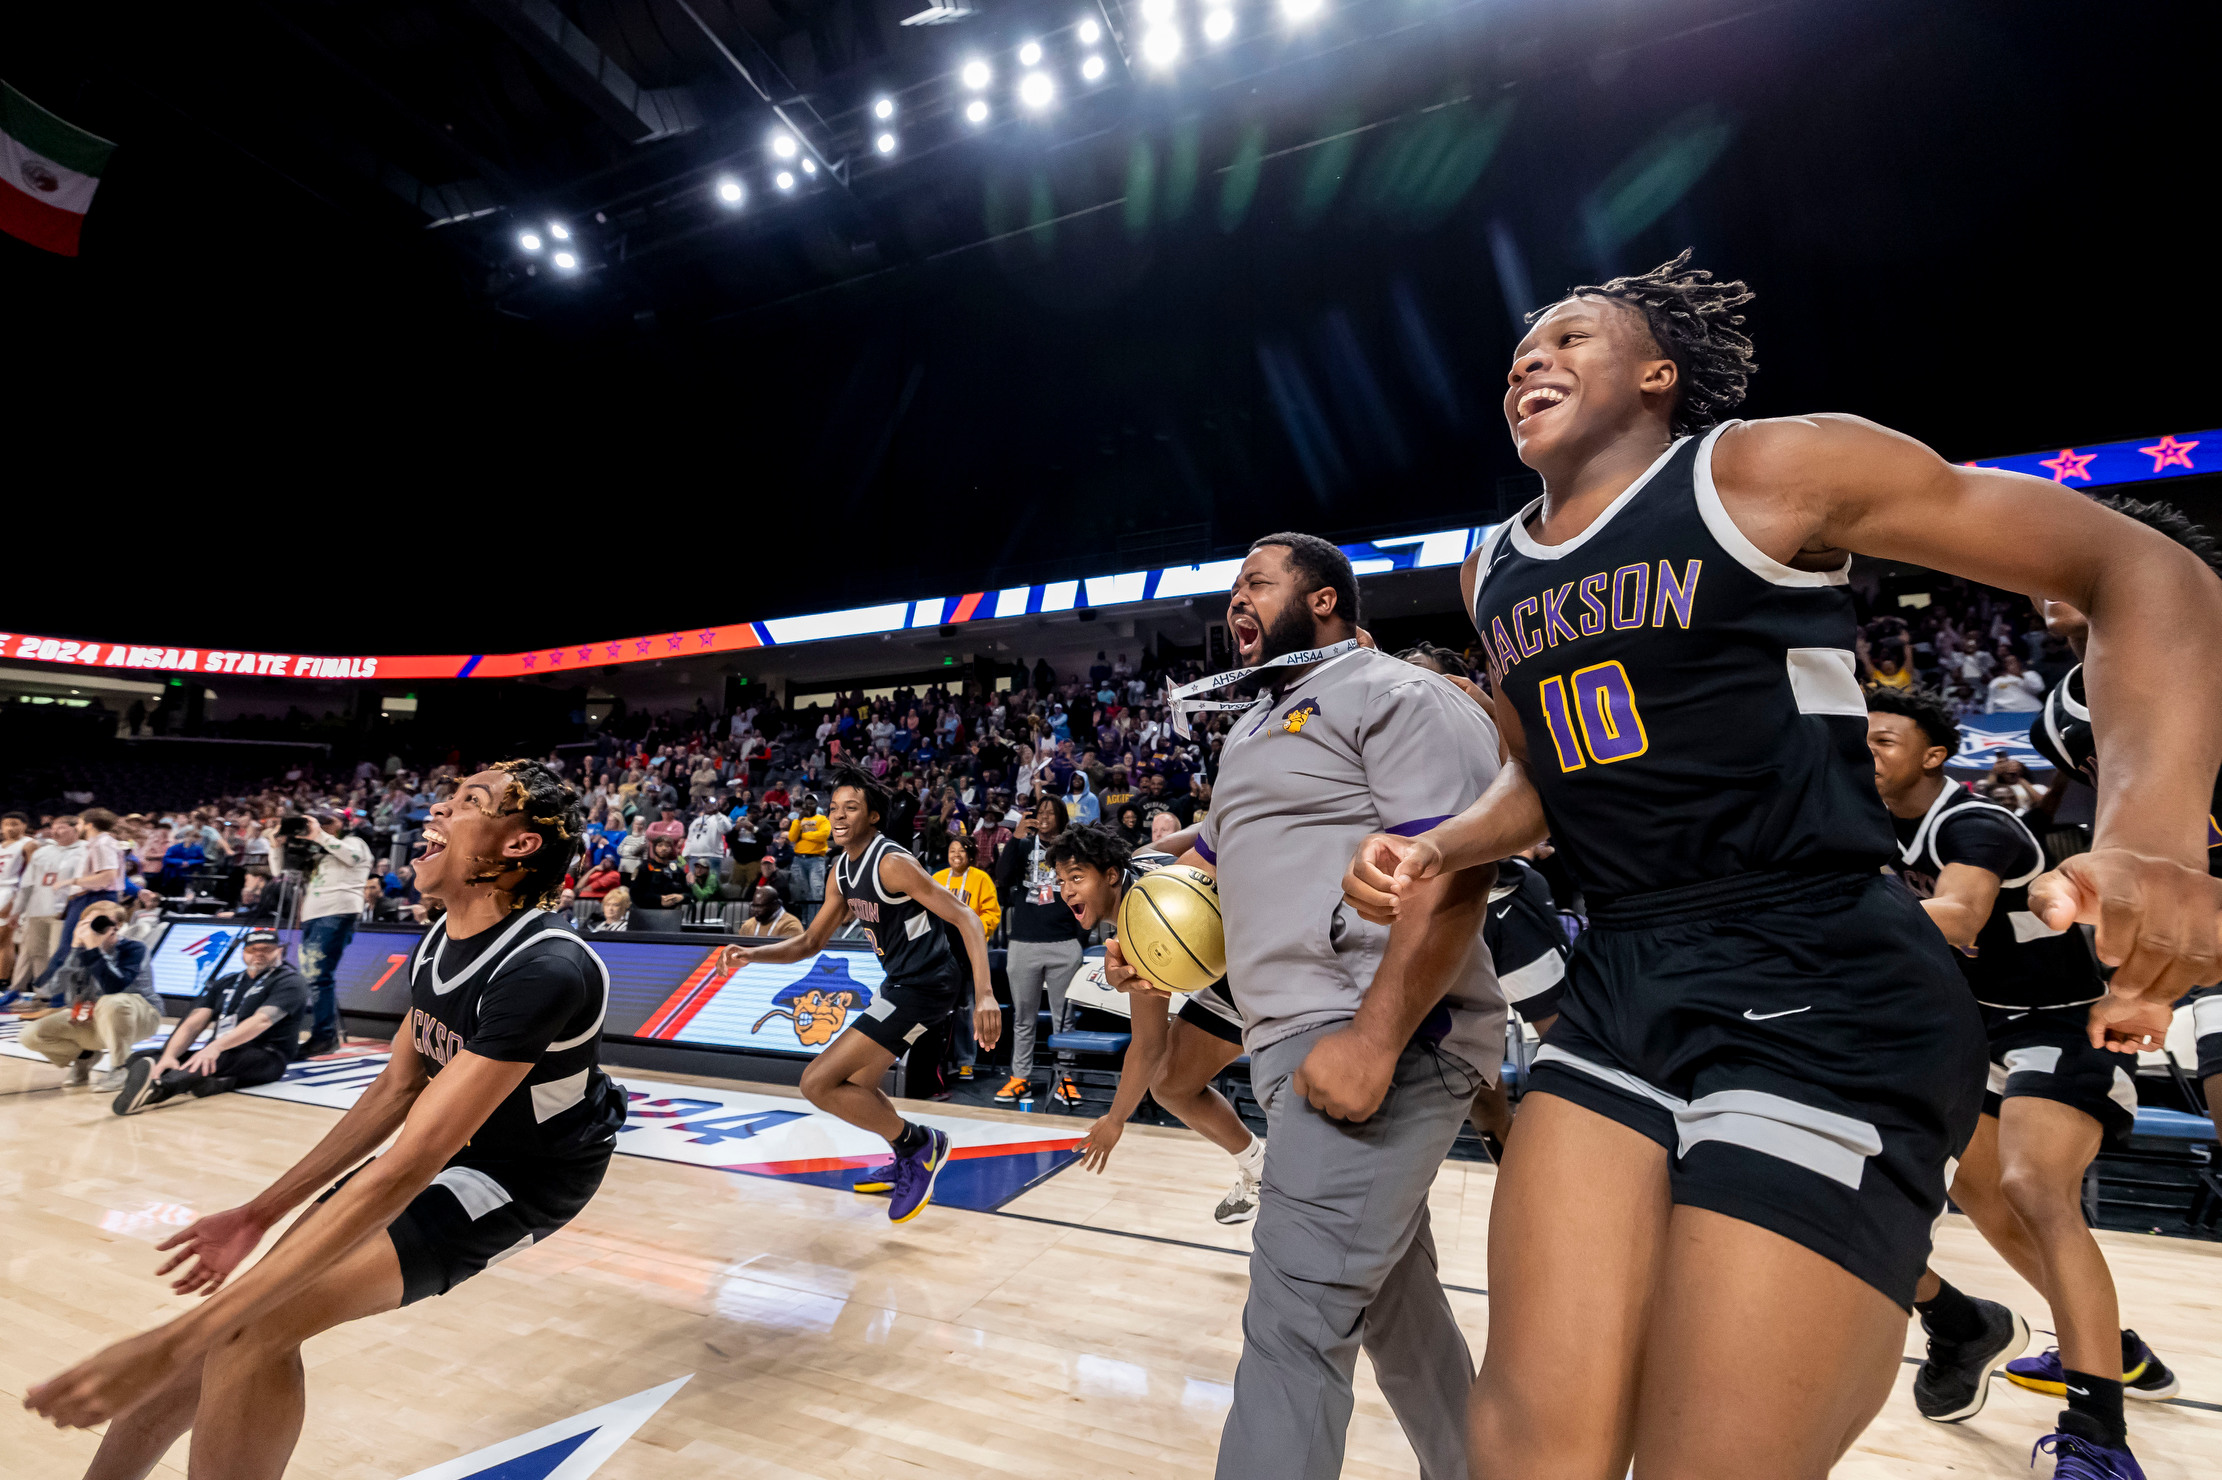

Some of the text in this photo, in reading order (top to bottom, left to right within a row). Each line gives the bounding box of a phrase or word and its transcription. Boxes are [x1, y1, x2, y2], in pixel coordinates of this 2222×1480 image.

[16, 637, 100, 664] 2024
[105, 646, 198, 670] AHSAA
[204, 652, 291, 675] STATE
[294, 657, 378, 677] FINALS
[1287, 650, 1324, 664] AHSAA
[1212, 669, 1252, 687] AHSAA
[1539, 660, 1649, 774] 10
[1106, 794, 1134, 806] AGGIE
